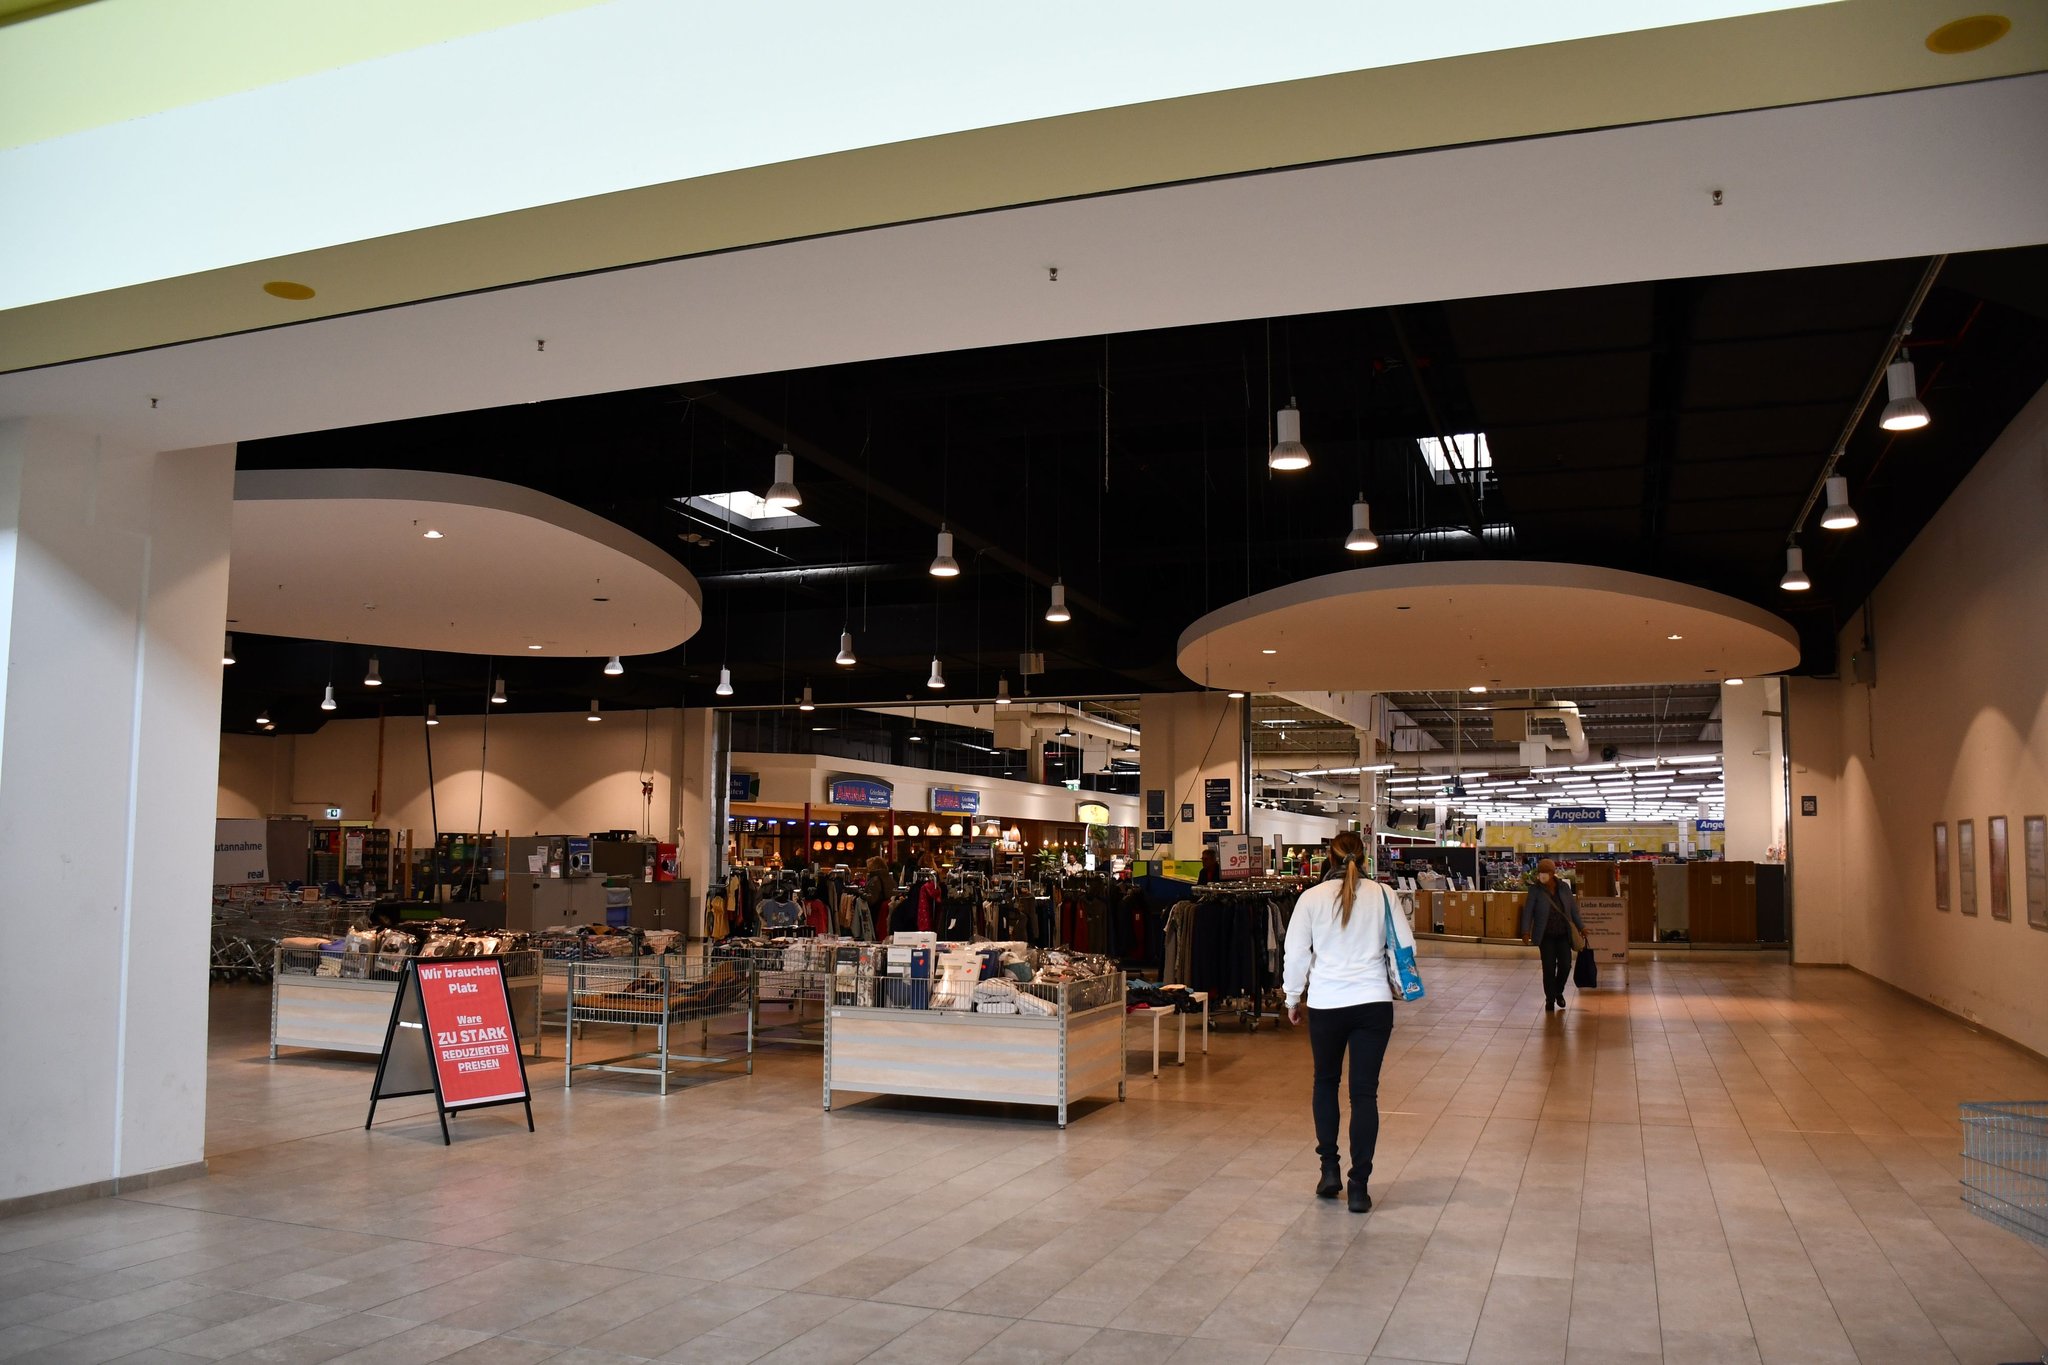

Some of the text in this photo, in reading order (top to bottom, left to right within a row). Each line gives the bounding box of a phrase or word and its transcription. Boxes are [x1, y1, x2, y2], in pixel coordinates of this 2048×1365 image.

[1552, 809, 1601, 822] Angebot
[1700, 820, 1724, 831] Ange
[247, 869, 264, 879] real
[420, 965, 498, 980] Wir brauchen
[448, 983, 478, 994] Platz
[457, 1015, 482, 1025] Ware
[437, 1026, 507, 1045] ZU STARK
[442, 1044, 509, 1059] REDUZIERTEN
[458, 1058, 500, 1071] PREISEN
